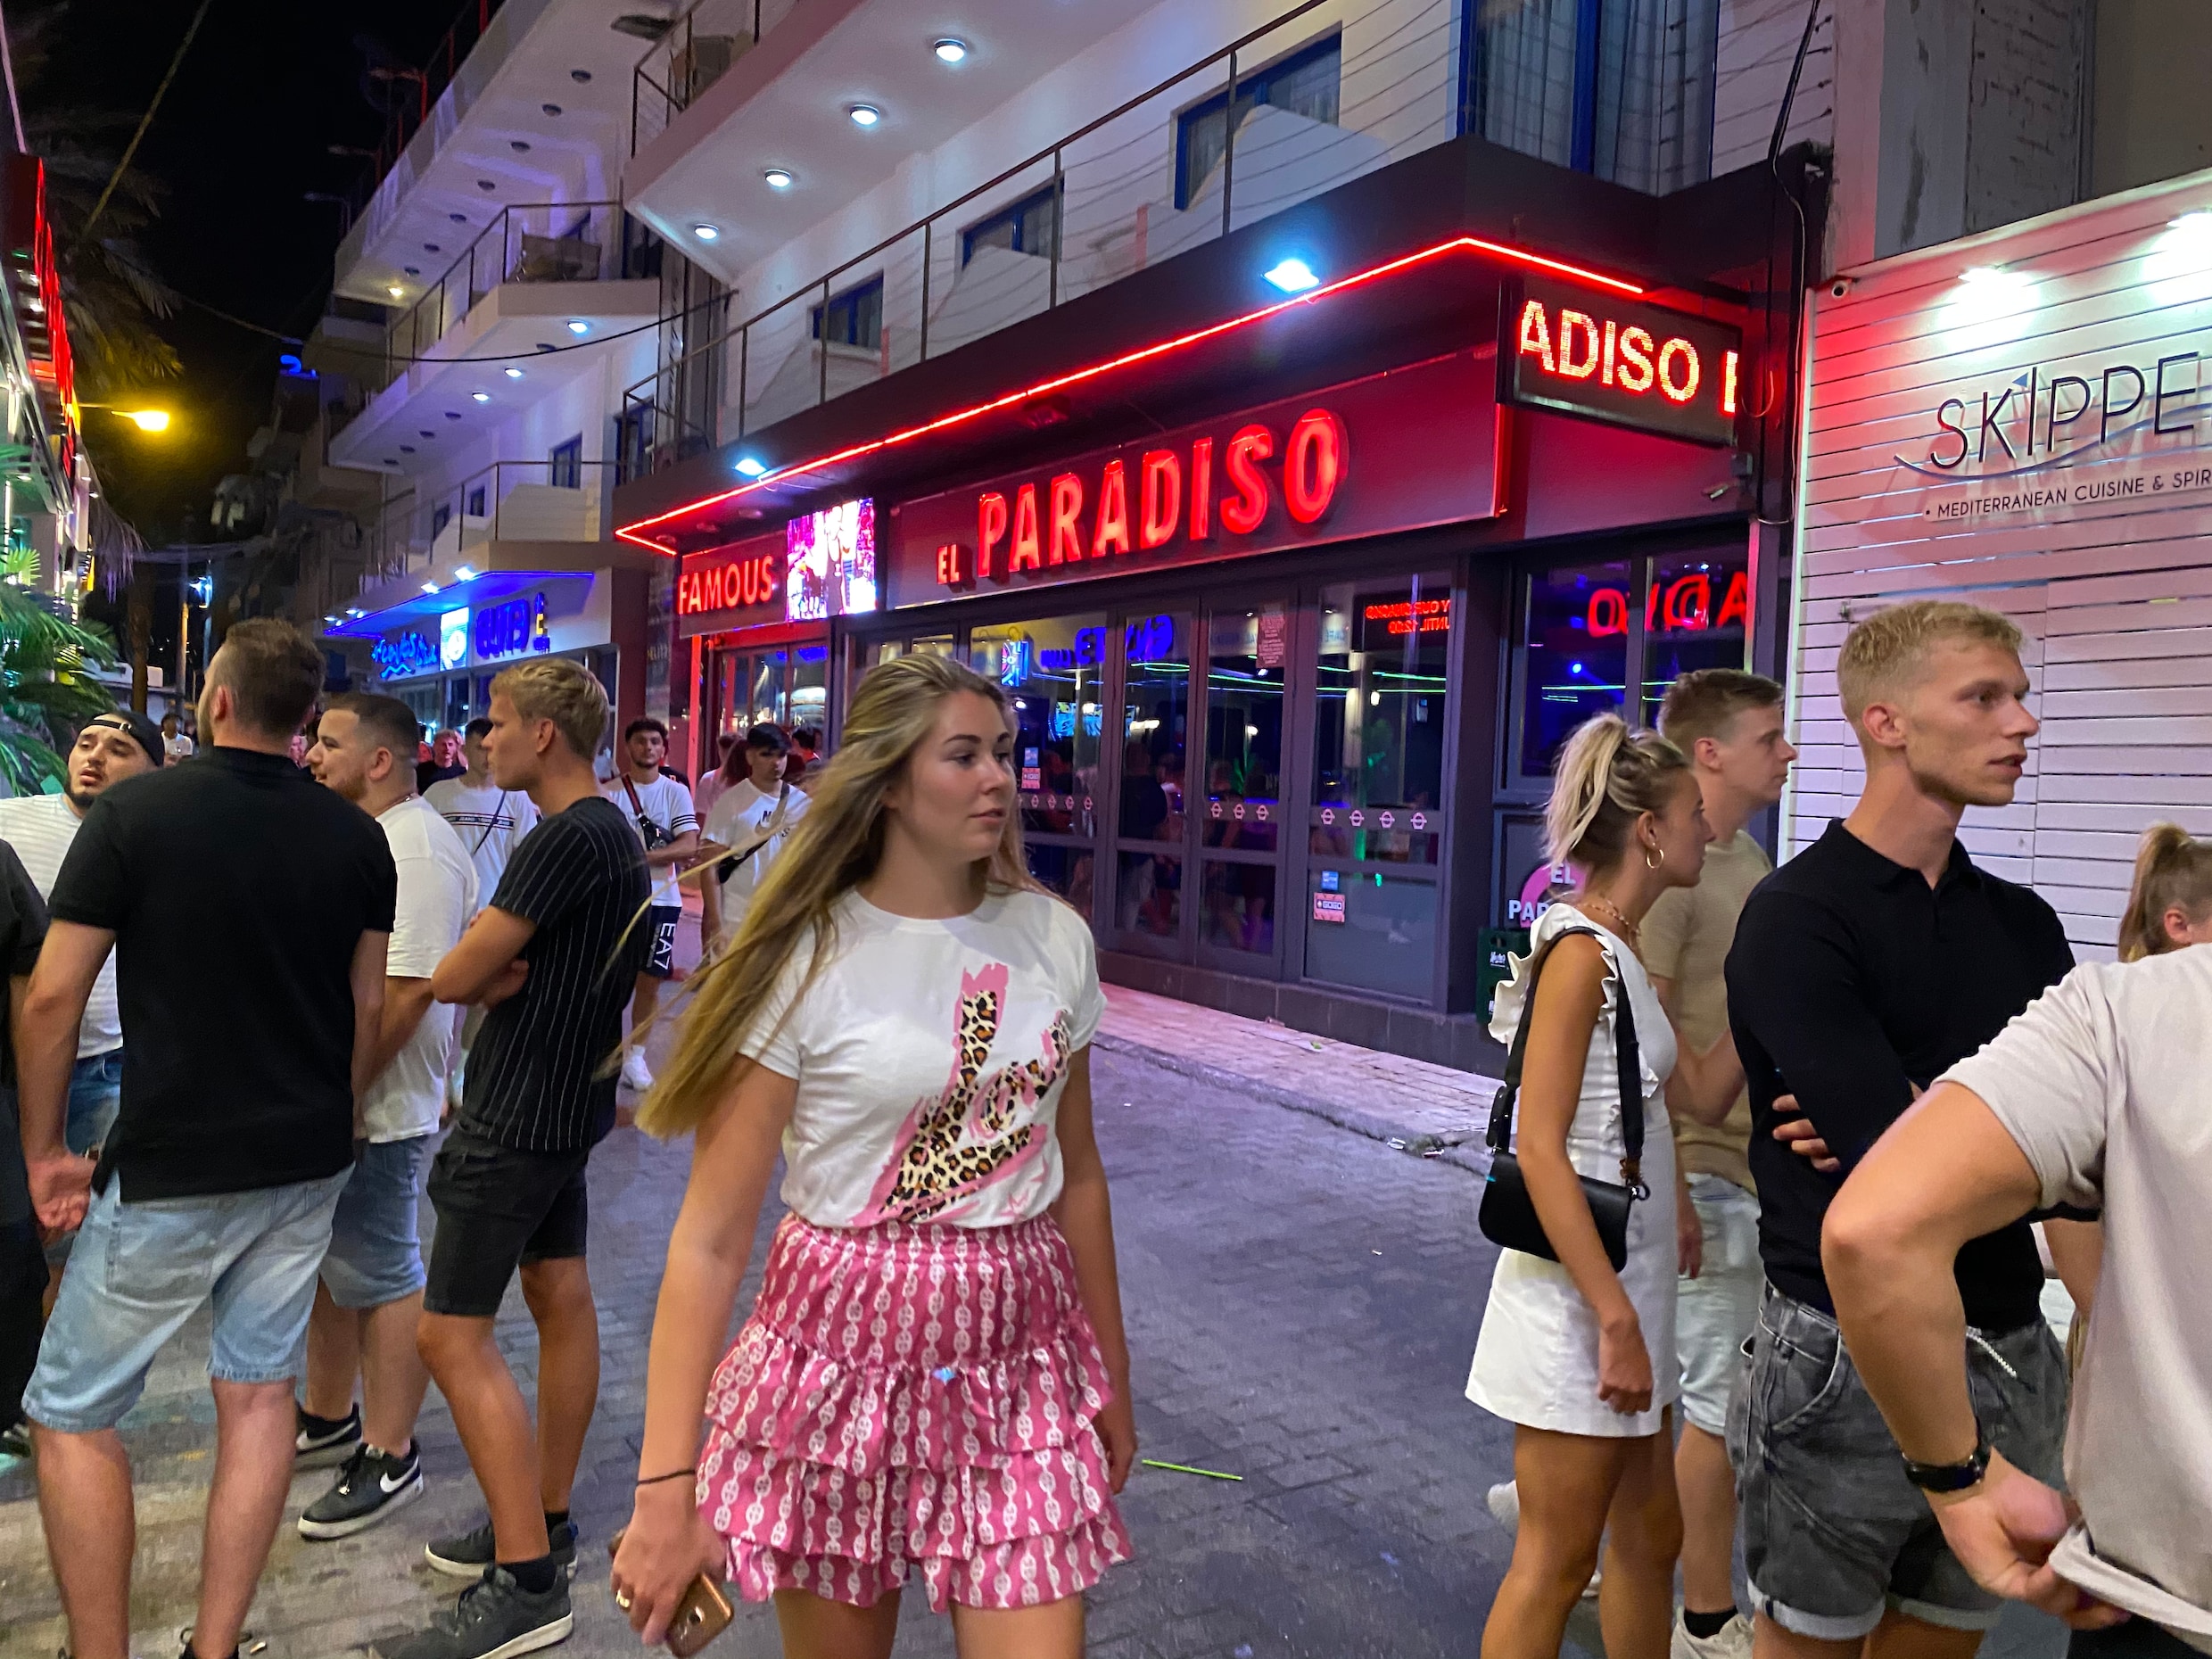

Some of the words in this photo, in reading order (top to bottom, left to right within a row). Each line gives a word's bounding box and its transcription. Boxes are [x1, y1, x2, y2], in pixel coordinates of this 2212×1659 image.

[1520, 300, 1700, 401] ADISO
[937, 544, 961, 585] EL
[978, 408, 1341, 578] PARADISO
[1937, 488, 2068, 518] MEDITERRANEAN
[2075, 477, 2145, 501] CUISINE
[2151, 475, 2165, 491] &
[678, 555, 773, 615] FAMOUS
[1551, 865, 1576, 884] EL
[654, 922, 677, 970] EA7
